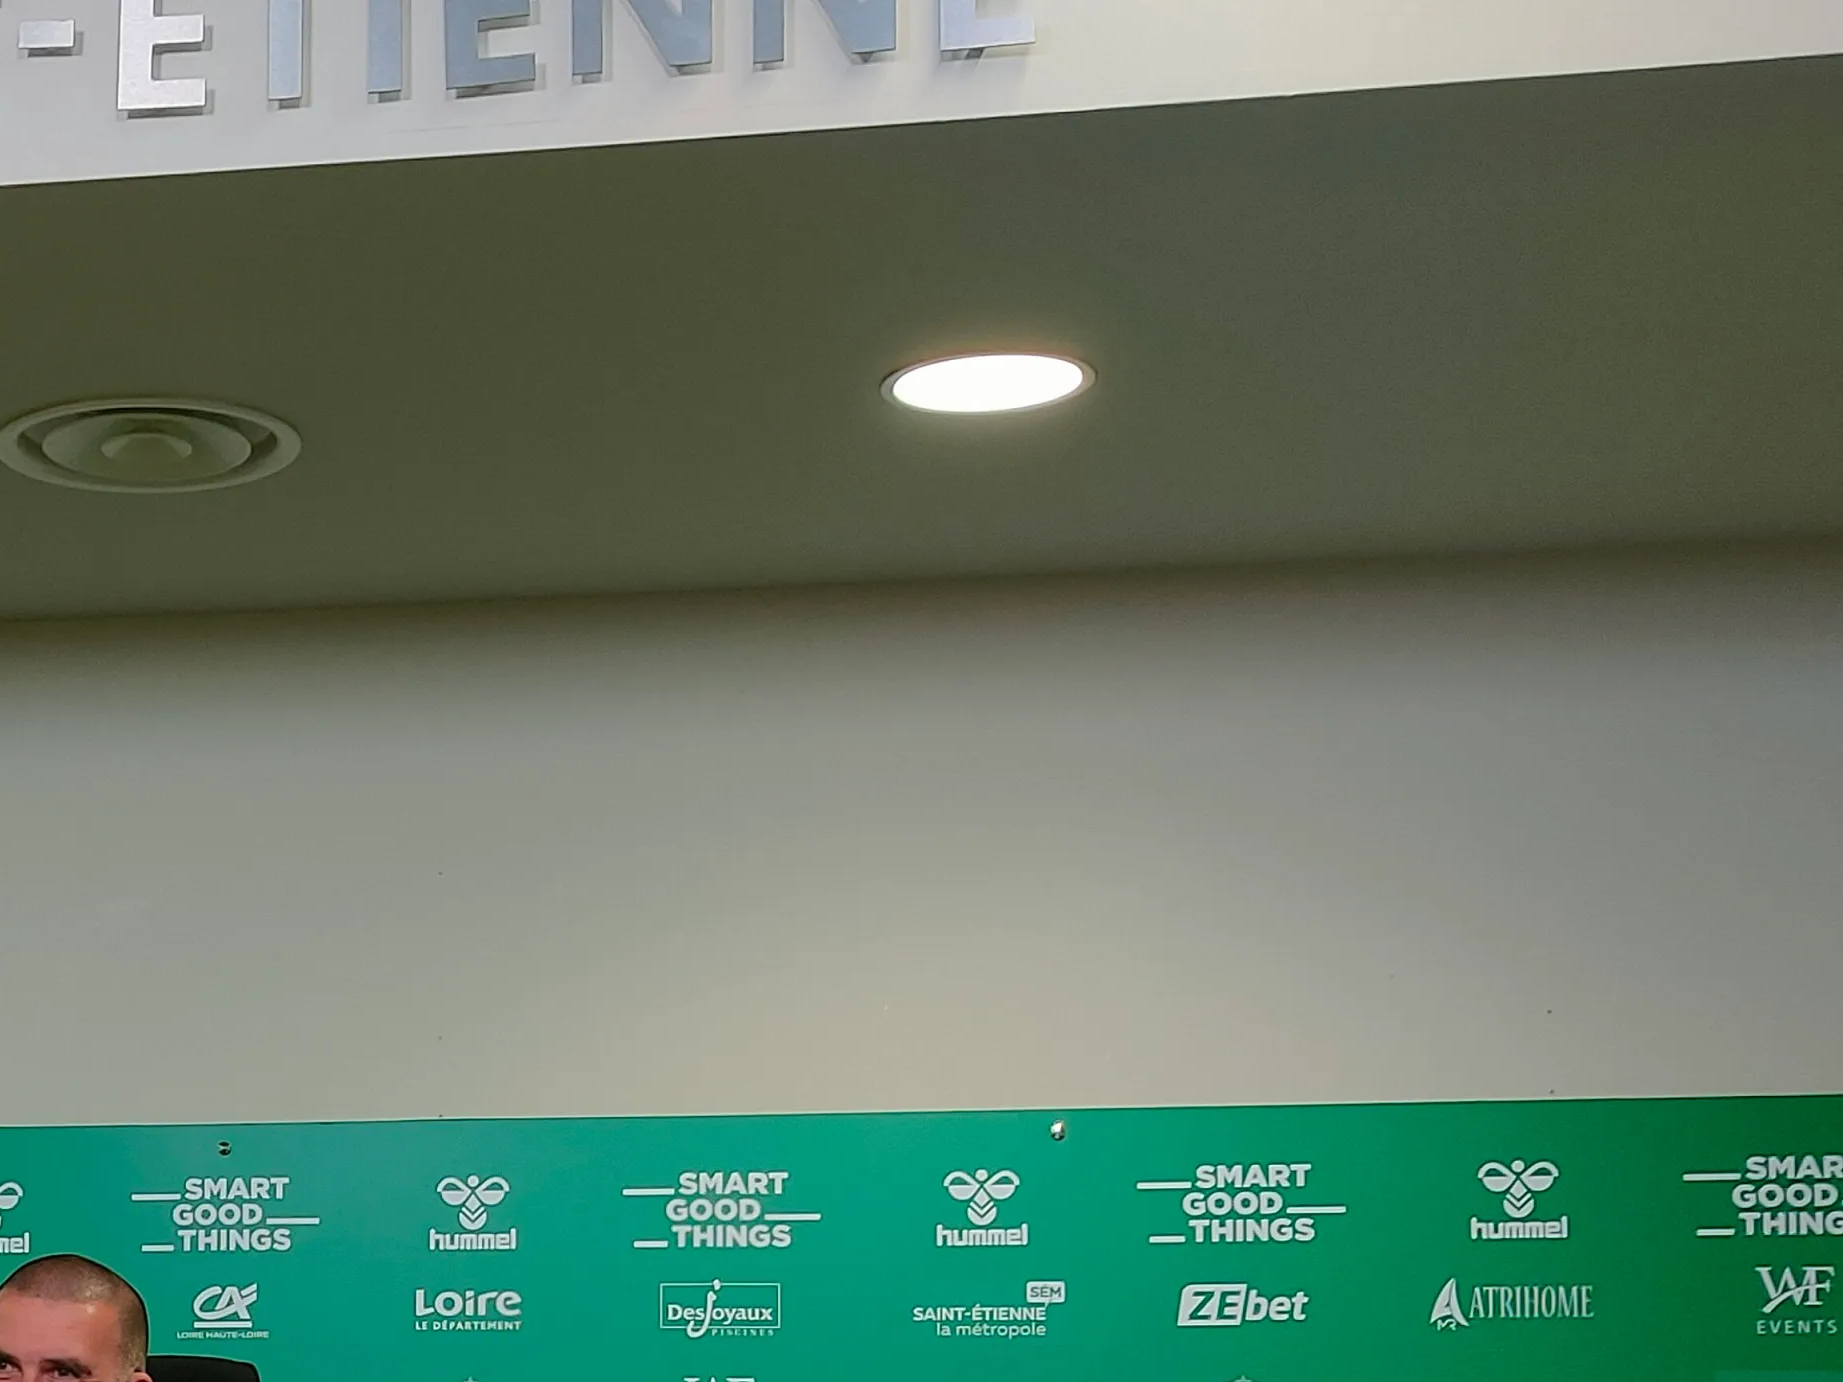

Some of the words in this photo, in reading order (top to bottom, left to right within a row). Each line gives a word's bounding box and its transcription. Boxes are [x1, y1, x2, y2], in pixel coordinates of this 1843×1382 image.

[1195, 1164, 1311, 1188] SMART
[1746, 1155, 1843, 1180] SMAR
[185, 1177, 289, 1200] SMART
[678, 1172, 788, 1195] SMART
[1183, 1191, 1283, 1216] GOOD
[1732, 1183, 1838, 1208] GOOD
[173, 1203, 262, 1226] GOOD
[666, 1198, 761, 1221] GOOD
[936, 1223, 1028, 1246] hummel
[1188, 1218, 1315, 1242] THINGS
[1471, 1216, 1568, 1239] hummel
[1738, 1211, 1843, 1235] THING
[177, 1228, 291, 1251] THINGS
[430, 1228, 516, 1250] hummel
[671, 1224, 791, 1247] THINGS
[416, 1289, 521, 1316] Loire
[913, 1302, 1046, 1321] SAINT-ÉTIENNE
[1469, 1286, 1593, 1318] ATRIHOME
[415, 1321, 427, 1330] LE
[433, 1320, 522, 1330] DÉPARTEMENT
[711, 1327, 774, 1336] PISCINES
[937, 1322, 951, 1336] la
[956, 1322, 1046, 1339] métropole
[1757, 1320, 1837, 1334] EVENTS
